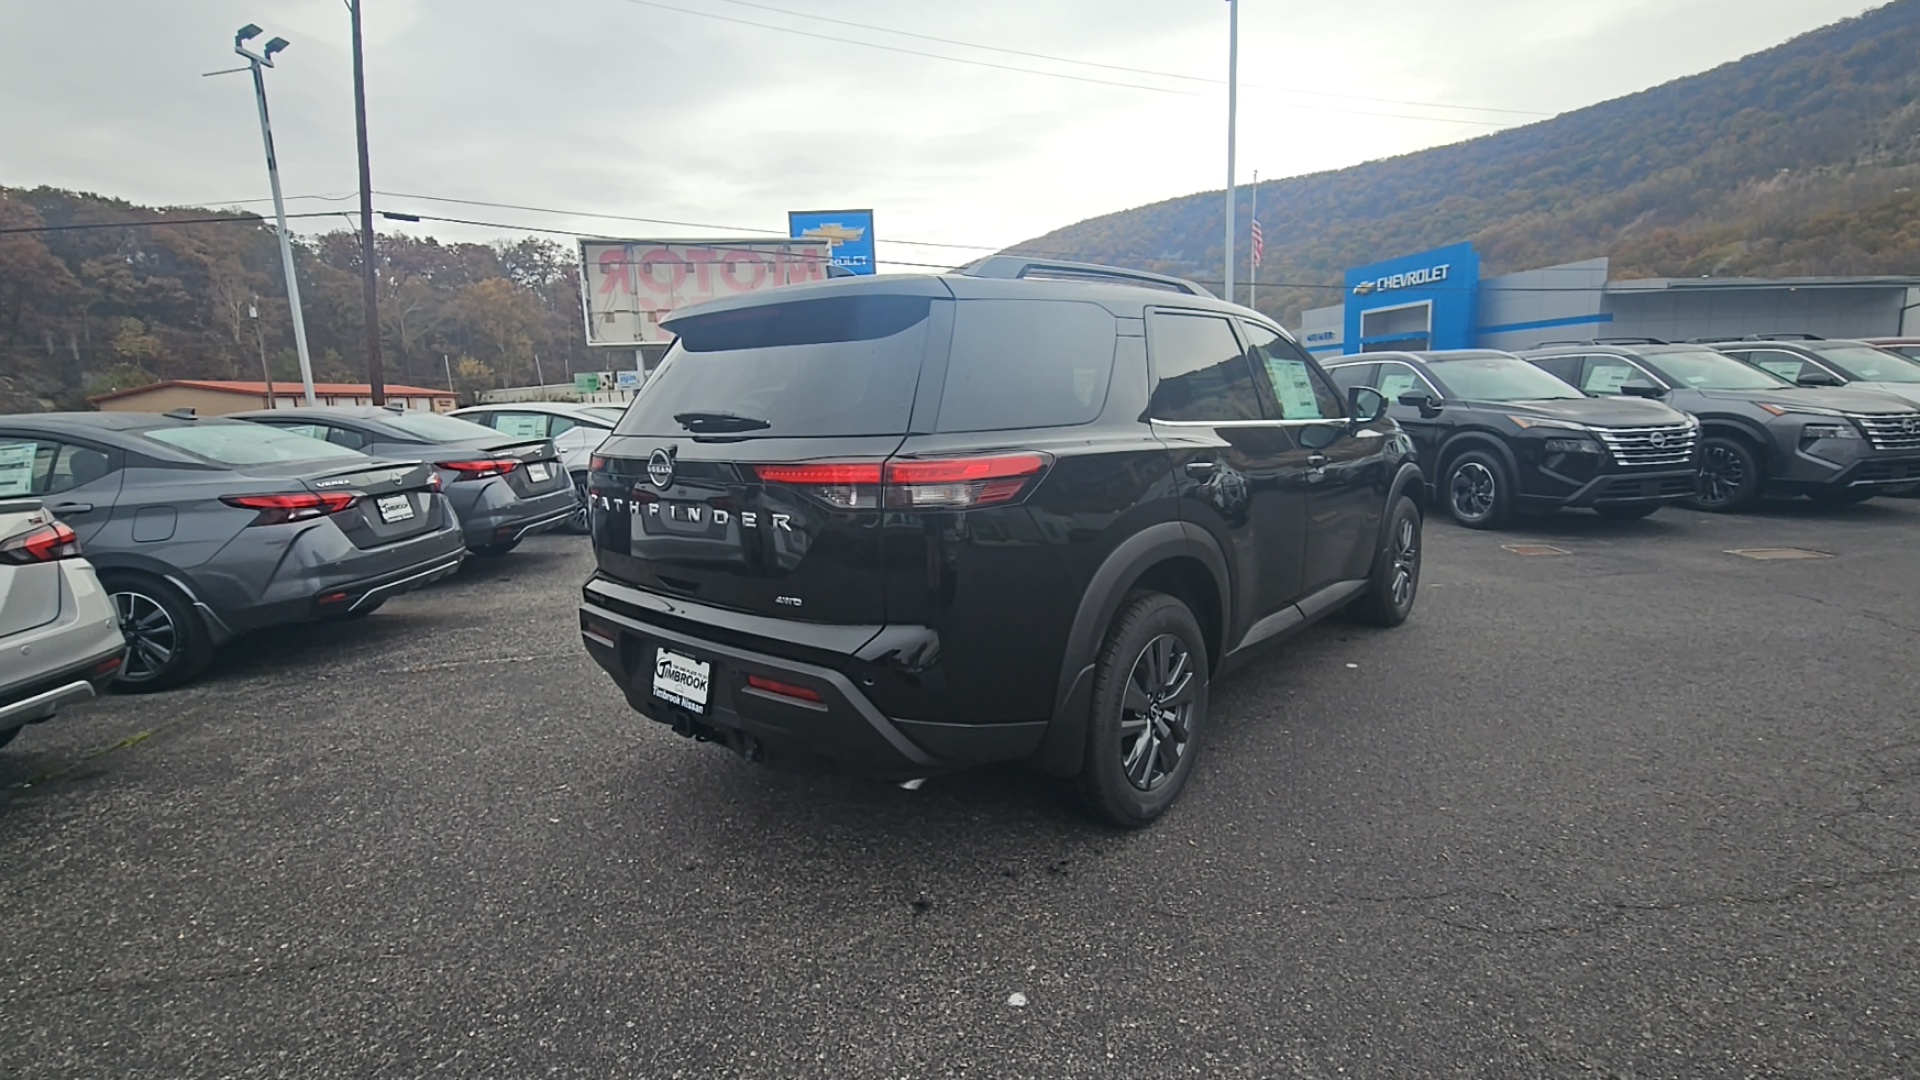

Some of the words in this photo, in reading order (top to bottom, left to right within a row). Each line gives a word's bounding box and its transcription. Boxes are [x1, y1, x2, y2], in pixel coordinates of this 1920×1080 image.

[1377, 264, 1450, 292] CHEVROLET
[591, 493, 793, 532] PATHFINDER
[656, 657, 708, 692] TIMBROOK
[653, 685, 680, 705] Timbrook
[681, 696, 704, 715] Nissan
